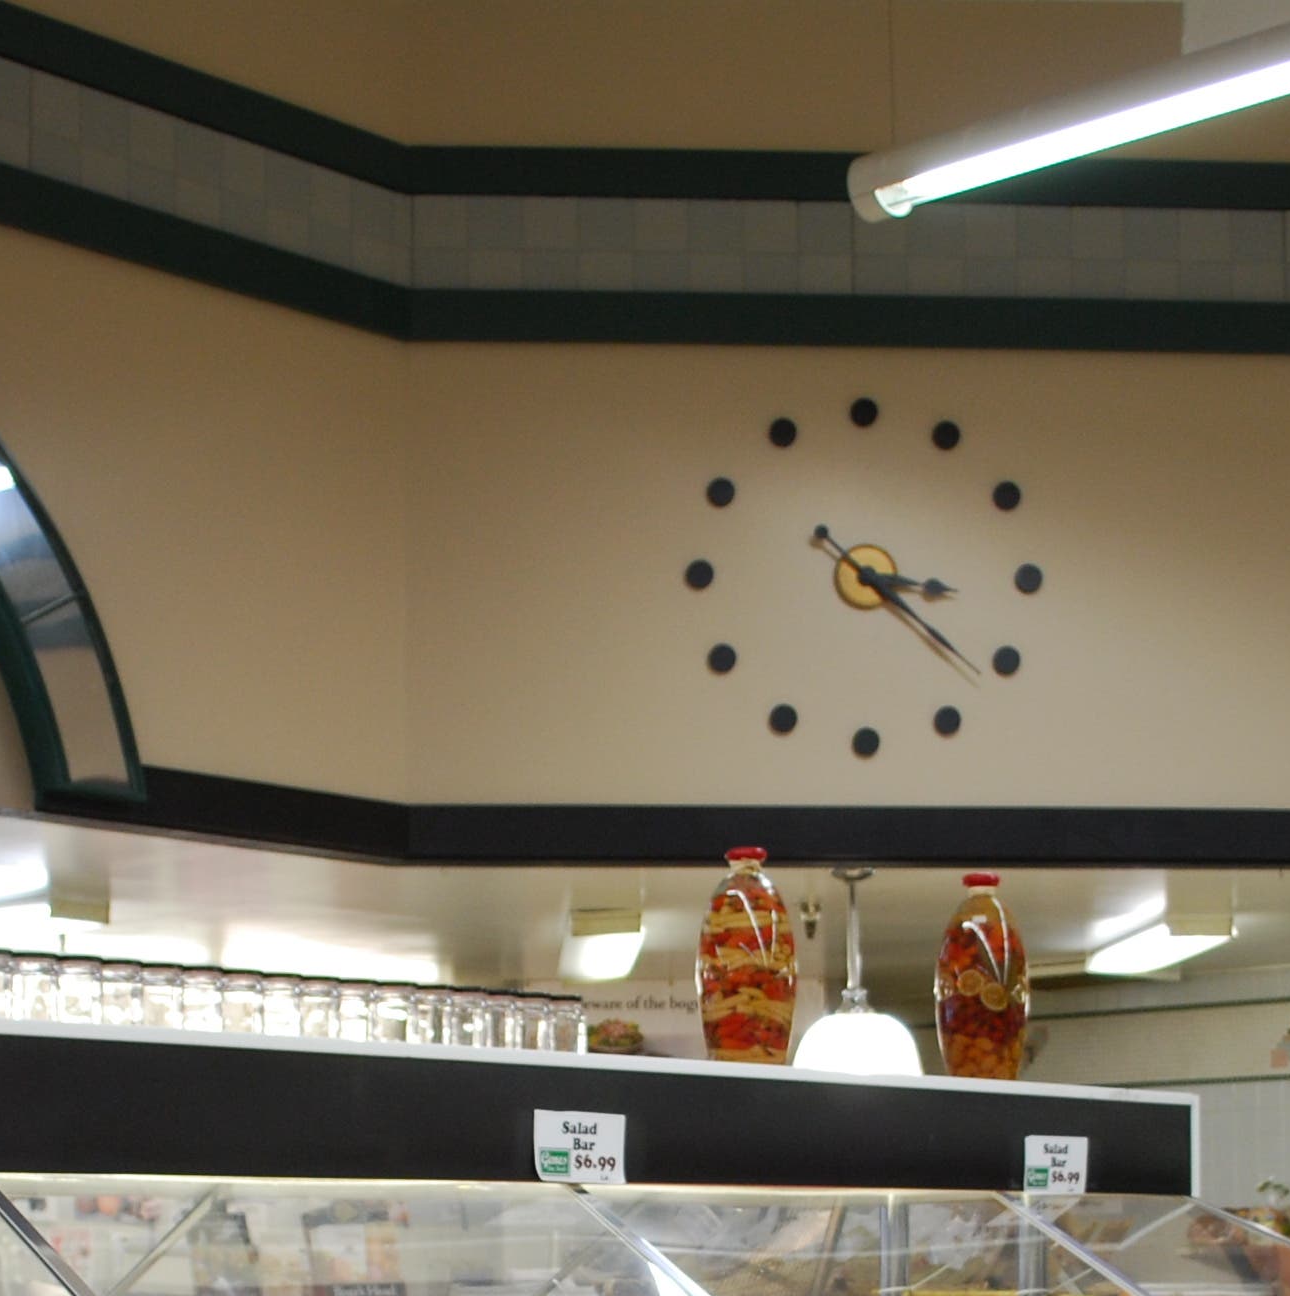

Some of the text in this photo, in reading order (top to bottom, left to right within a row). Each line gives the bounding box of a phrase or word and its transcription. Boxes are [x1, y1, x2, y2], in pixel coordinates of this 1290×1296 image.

[643, 995, 663, 1010] the
[562, 1120, 598, 1135] Salad
[572, 1137, 596, 1151] Bar
[1043, 1143, 1069, 1155] Salad
[574, 1153, 616, 1172] $6.99
[1051, 1169, 1080, 1185] $6.99
